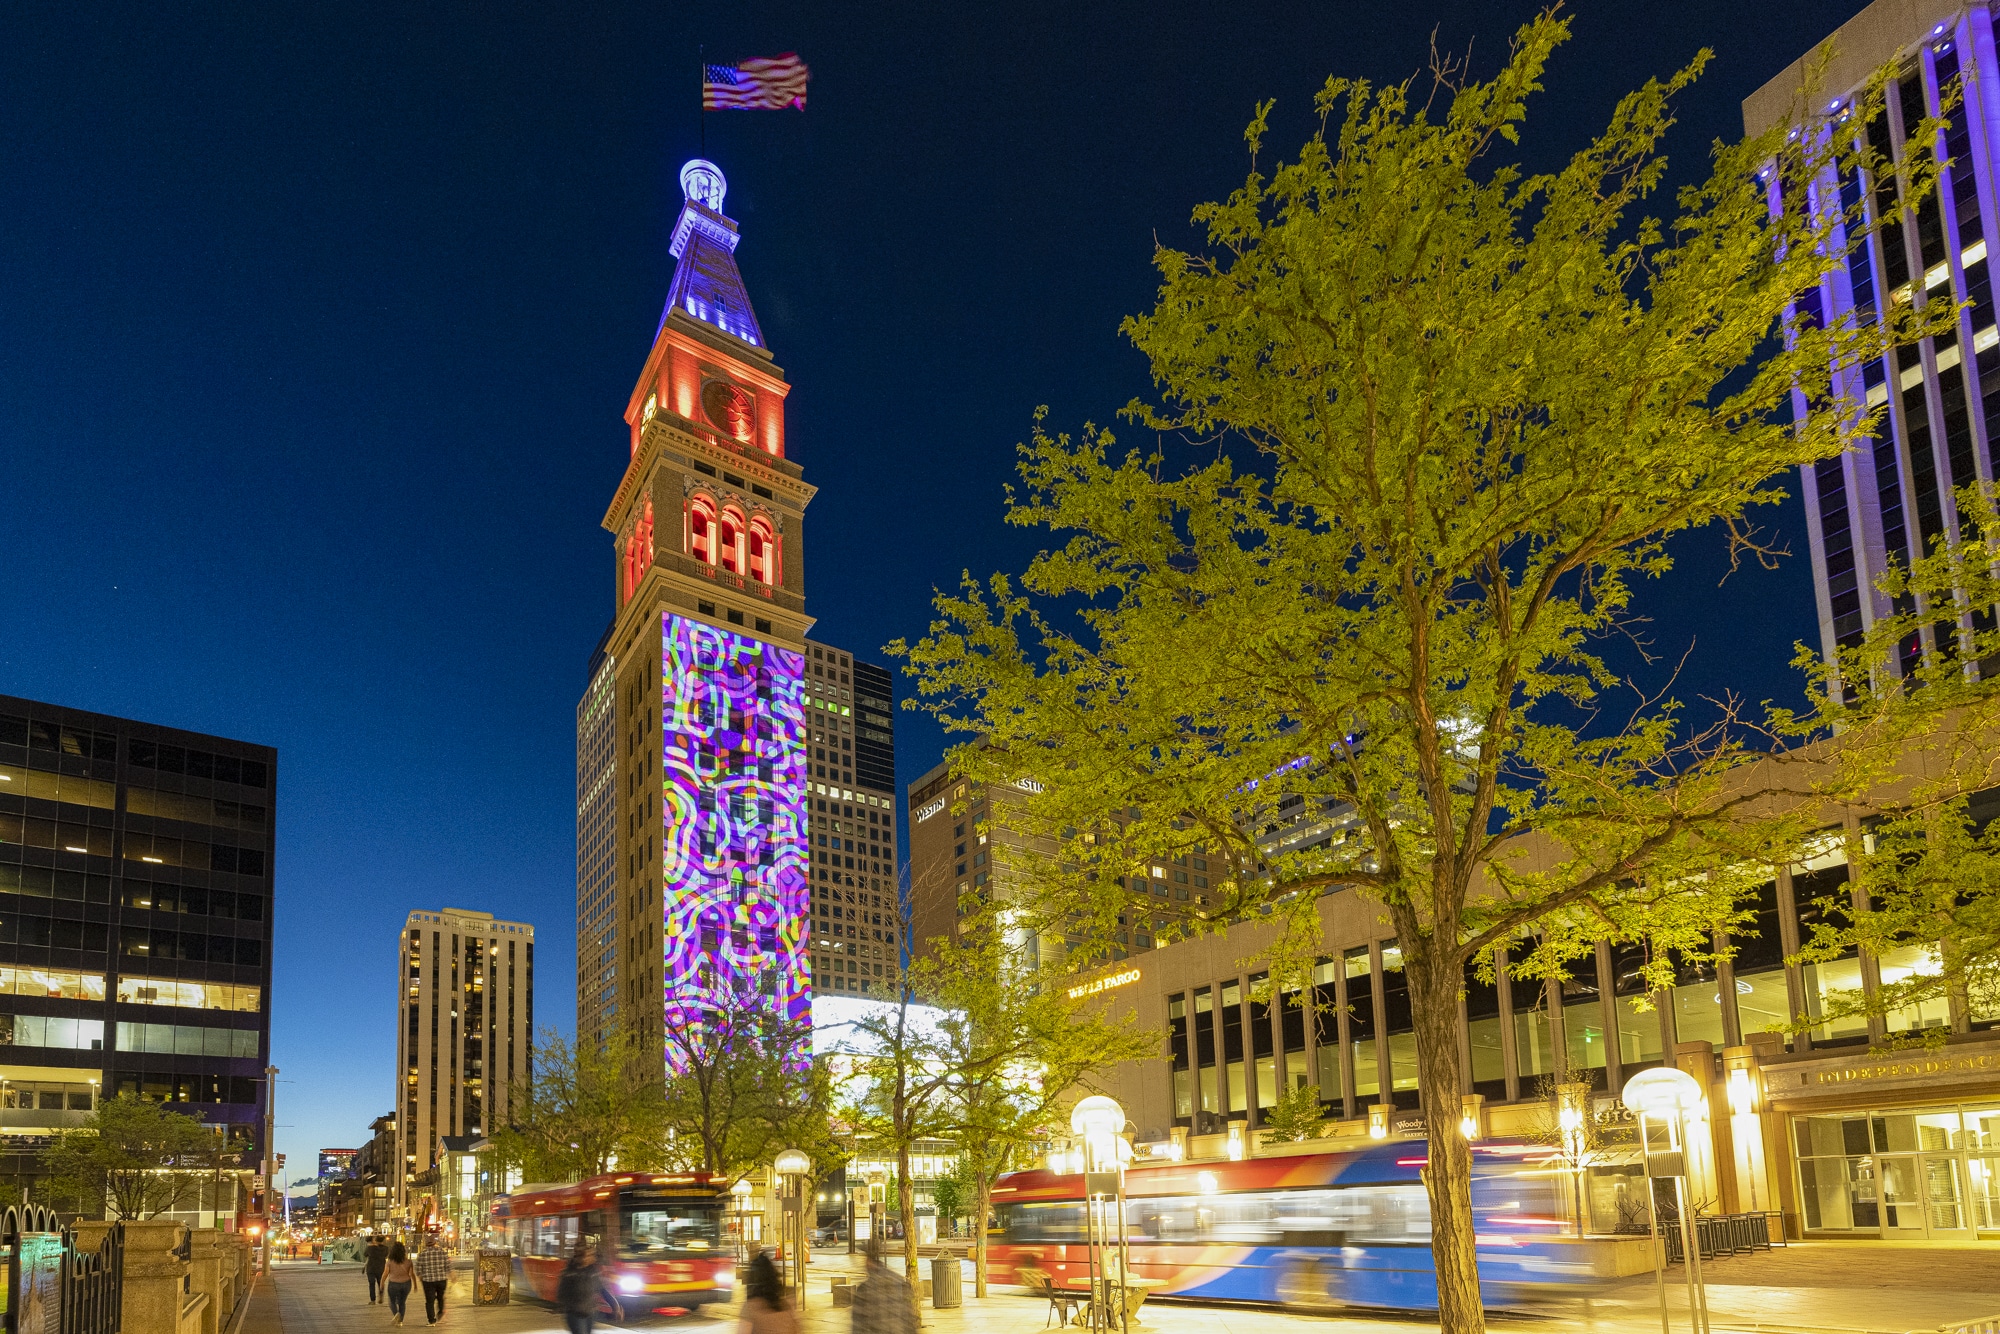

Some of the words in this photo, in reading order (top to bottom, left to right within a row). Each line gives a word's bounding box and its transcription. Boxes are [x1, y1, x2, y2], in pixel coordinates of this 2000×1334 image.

[915, 797, 945, 823] WESTIN
[1103, 969, 1141, 990] FARGO
[1816, 1055, 1998, 1084] INDEPENDENC
[1396, 1119, 1423, 1129] Woody
